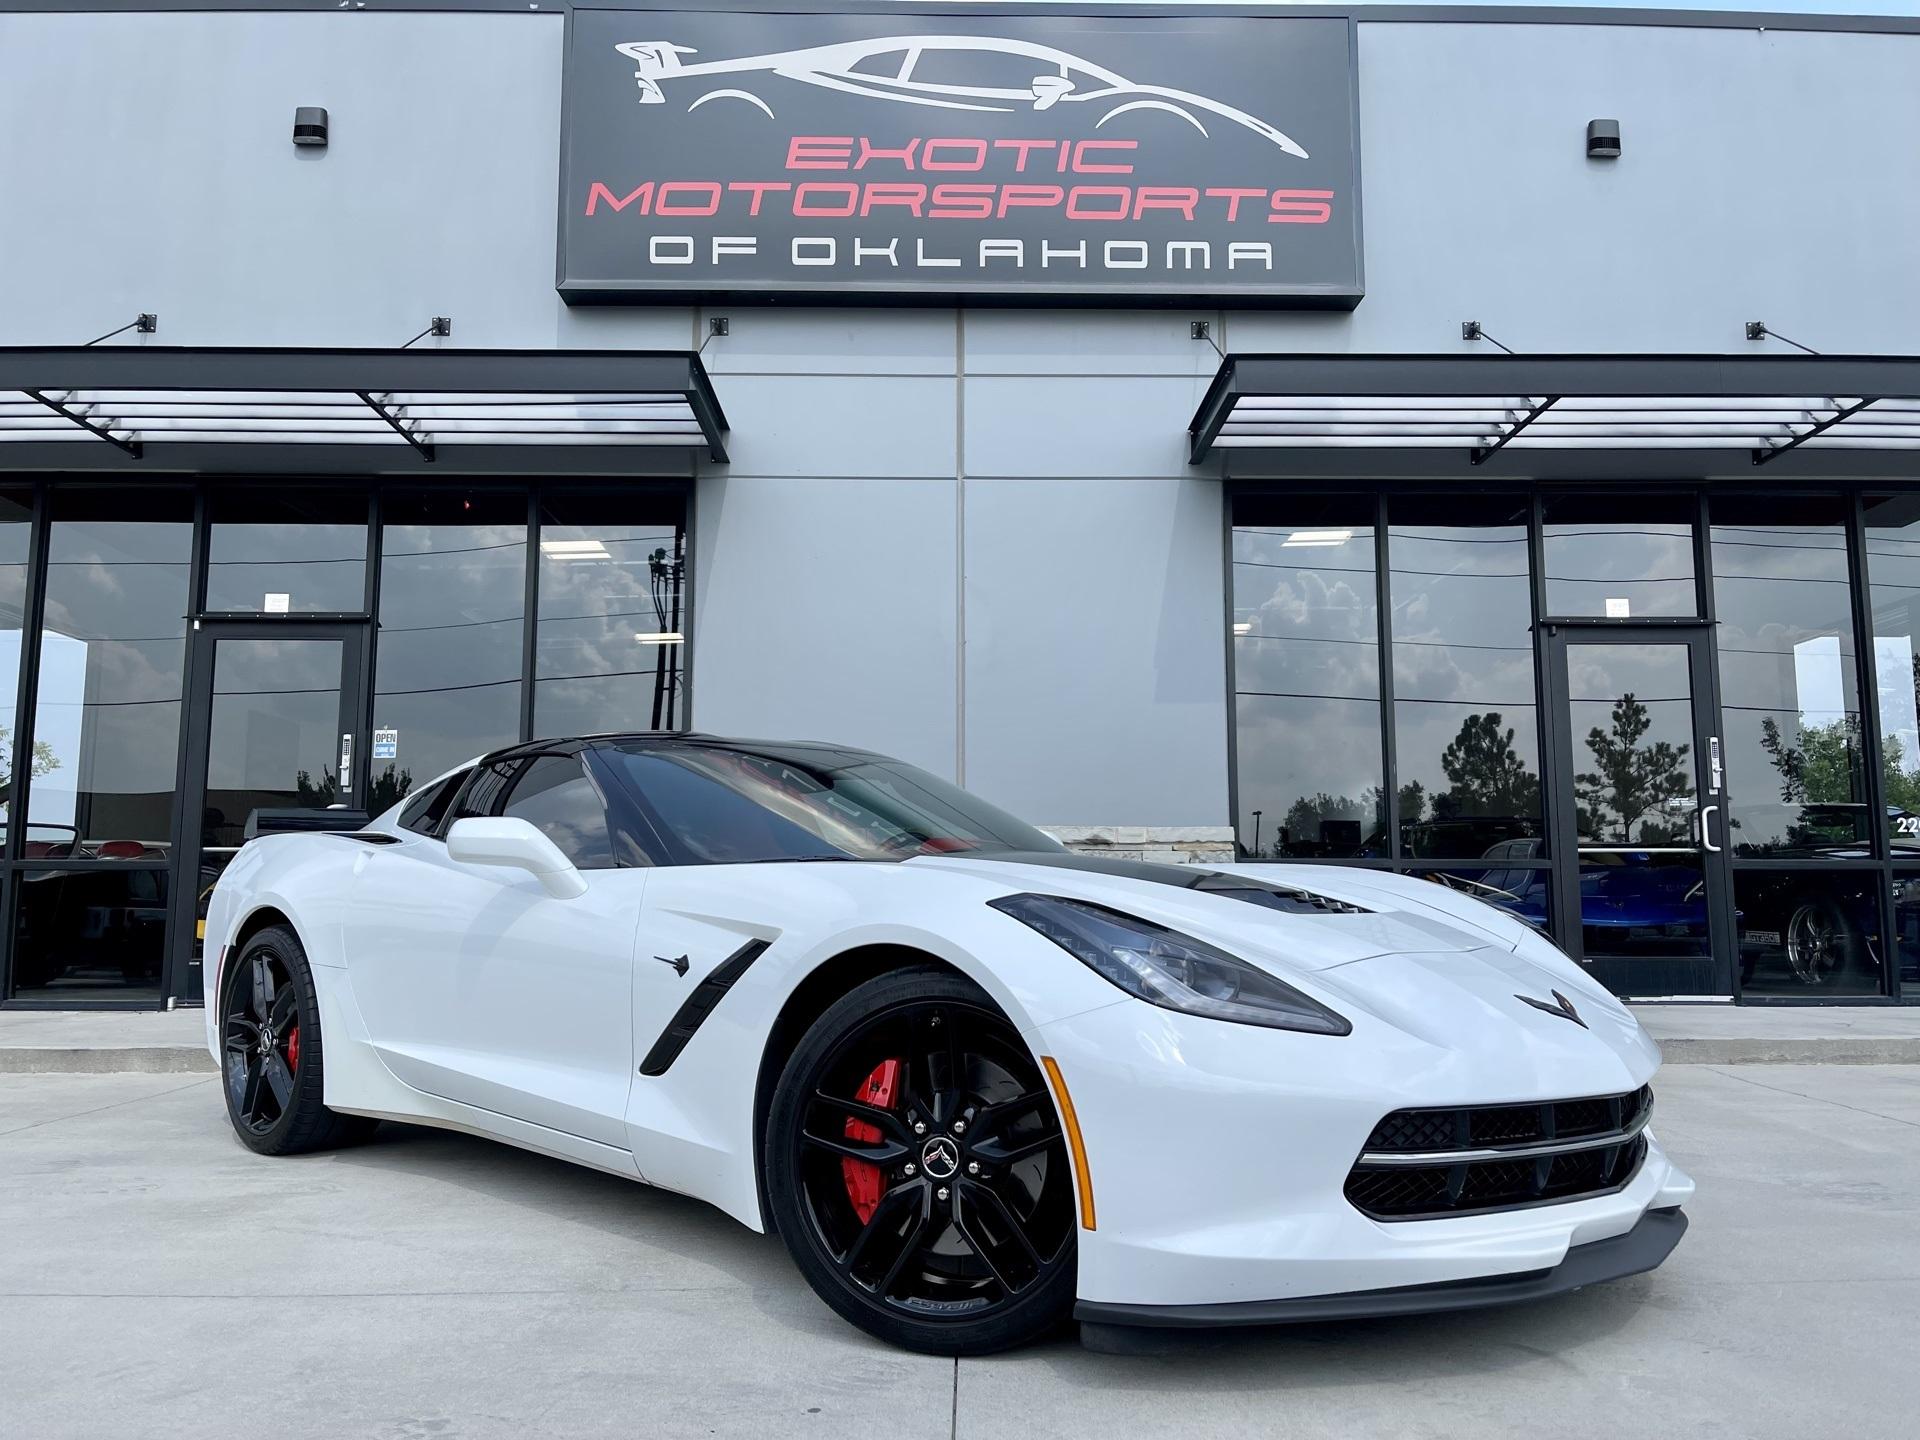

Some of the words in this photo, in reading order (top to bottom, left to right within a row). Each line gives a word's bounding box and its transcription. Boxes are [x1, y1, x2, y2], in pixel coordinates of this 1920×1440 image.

[785, 136, 1138, 173] EXOTIC
[585, 182, 1334, 224] MOTORSPORTS
[649, 235, 758, 265] OF
[791, 237, 1274, 270] OKLAHOMA
[376, 733, 396, 743] OPEN
[1896, 817, 1920, 833] 22
